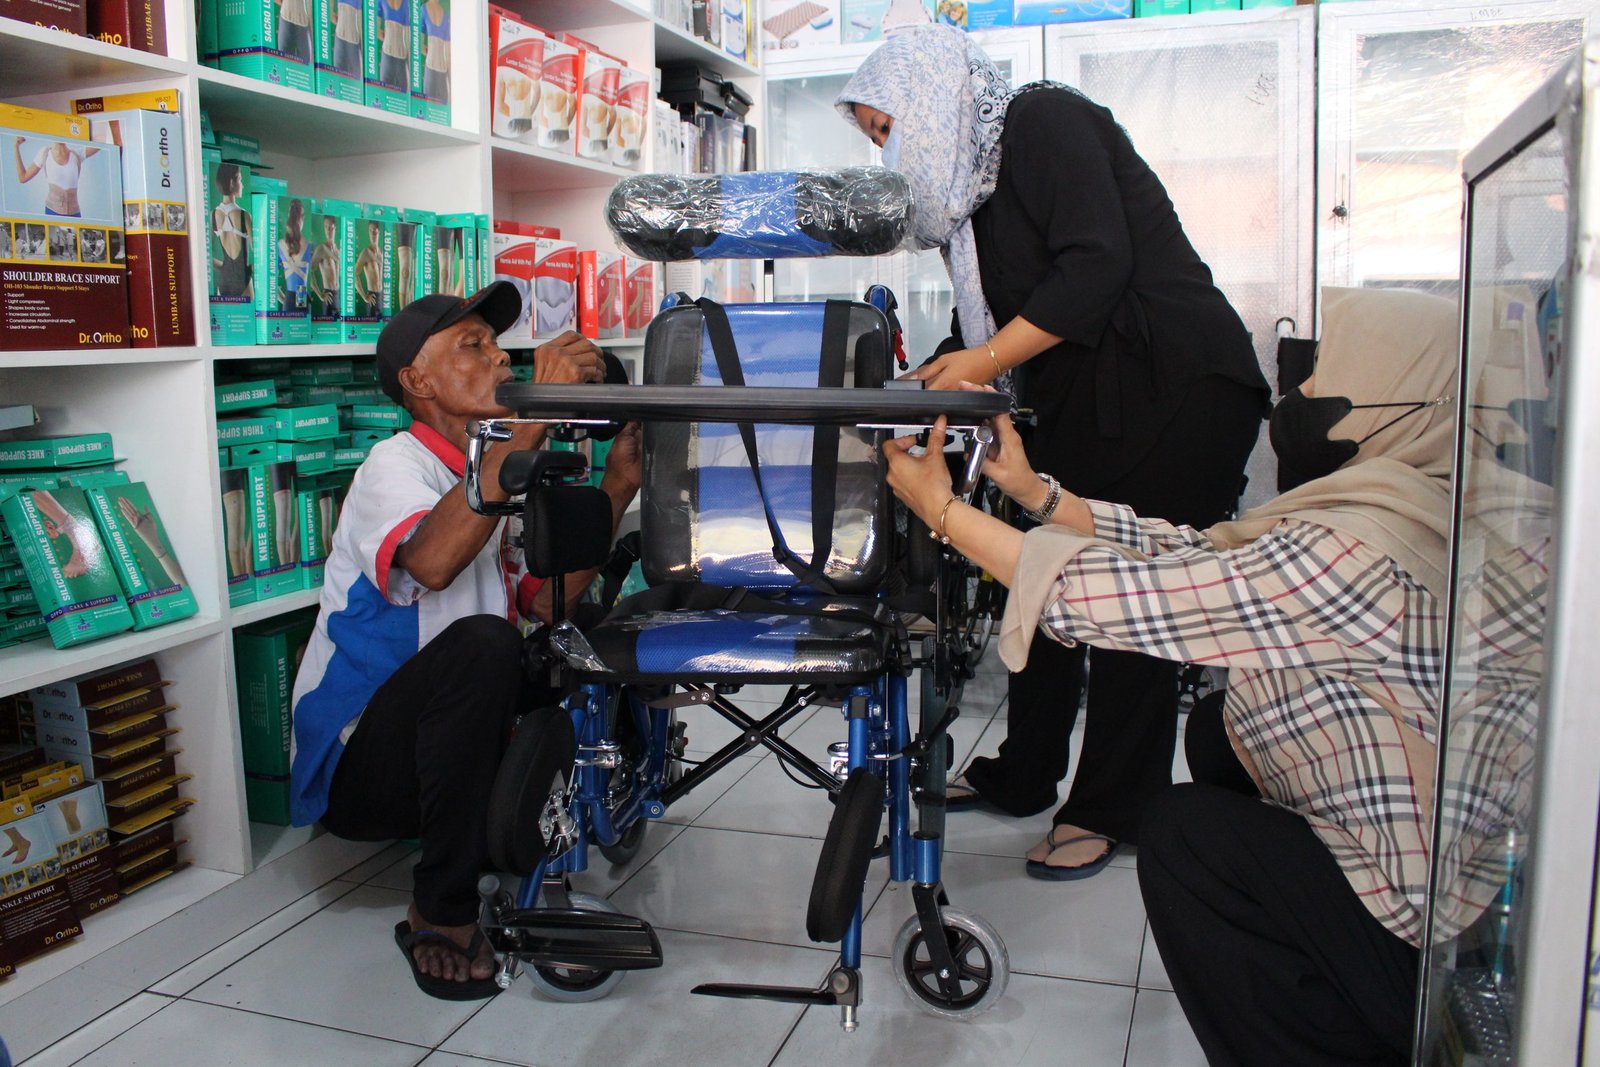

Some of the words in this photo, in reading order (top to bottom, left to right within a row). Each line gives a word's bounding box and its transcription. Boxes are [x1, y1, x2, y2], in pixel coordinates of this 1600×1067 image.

[264, 10, 272, 42] SACRO
[3, 271, 53, 282] SHOULDER
[55, 273, 84, 283] BRACE
[85, 274, 120, 284] SUPPORT
[167, 246, 176, 291] SUPPORT
[170, 293, 179, 335] LUMBAR
[79, 332, 122, 344] Dr.Ortho
[222, 391, 251, 404] SUPPORT
[252, 389, 268, 399] KNEE
[242, 425, 264, 436] THIGH
[295, 418, 316, 428] SUPPORT
[217, 428, 241, 439] SUPPO
[27, 450, 44, 459] KNEE
[58, 444, 86, 455] SUPPORT
[86, 442, 102, 451] KNEE
[255, 476, 266, 529] SUPPORT
[22, 496, 44, 535] SUPPORT
[96, 494, 117, 531] SUPPORT
[40, 538, 56, 565] ANKLE
[258, 532, 268, 562] KNEE
[113, 531, 142, 588] WRIST/THUMB
[51, 566, 71, 601] SILICON
[70, 603, 83, 611] CARE
[90, 597, 114, 606] SUPPORTS
[278, 657, 287, 697] COLLAR
[281, 701, 290, 752] CERVICAL
[72, 856, 98, 871] SUPPORT
[24, 885, 55, 902] SUPPORT
[45, 926, 79, 945] Dr.Ortho
